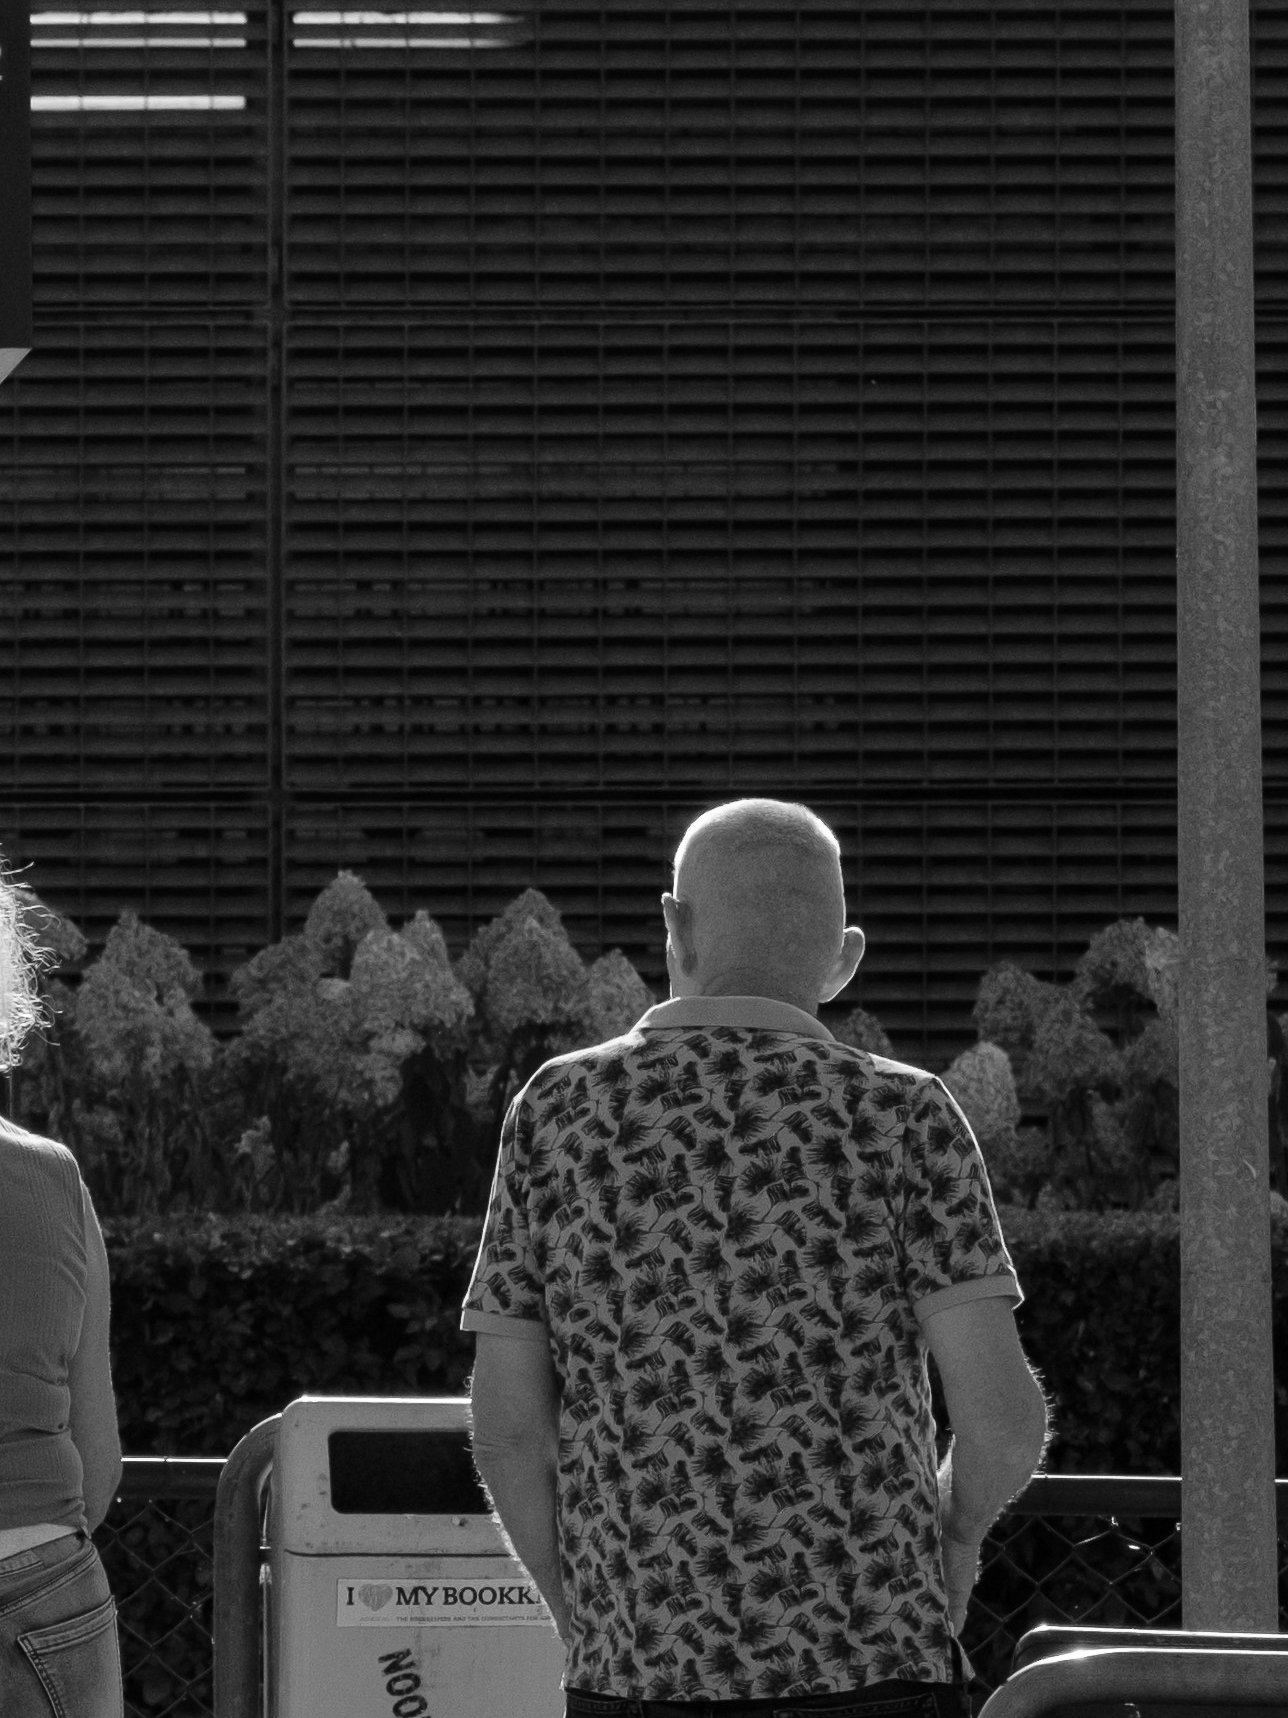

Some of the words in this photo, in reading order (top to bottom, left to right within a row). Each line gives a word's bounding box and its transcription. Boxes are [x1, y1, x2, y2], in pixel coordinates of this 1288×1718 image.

[346, 1586, 355, 1606] I
[395, 1586, 440, 1606] MY
[442, 1586, 542, 1606] BOOKK
